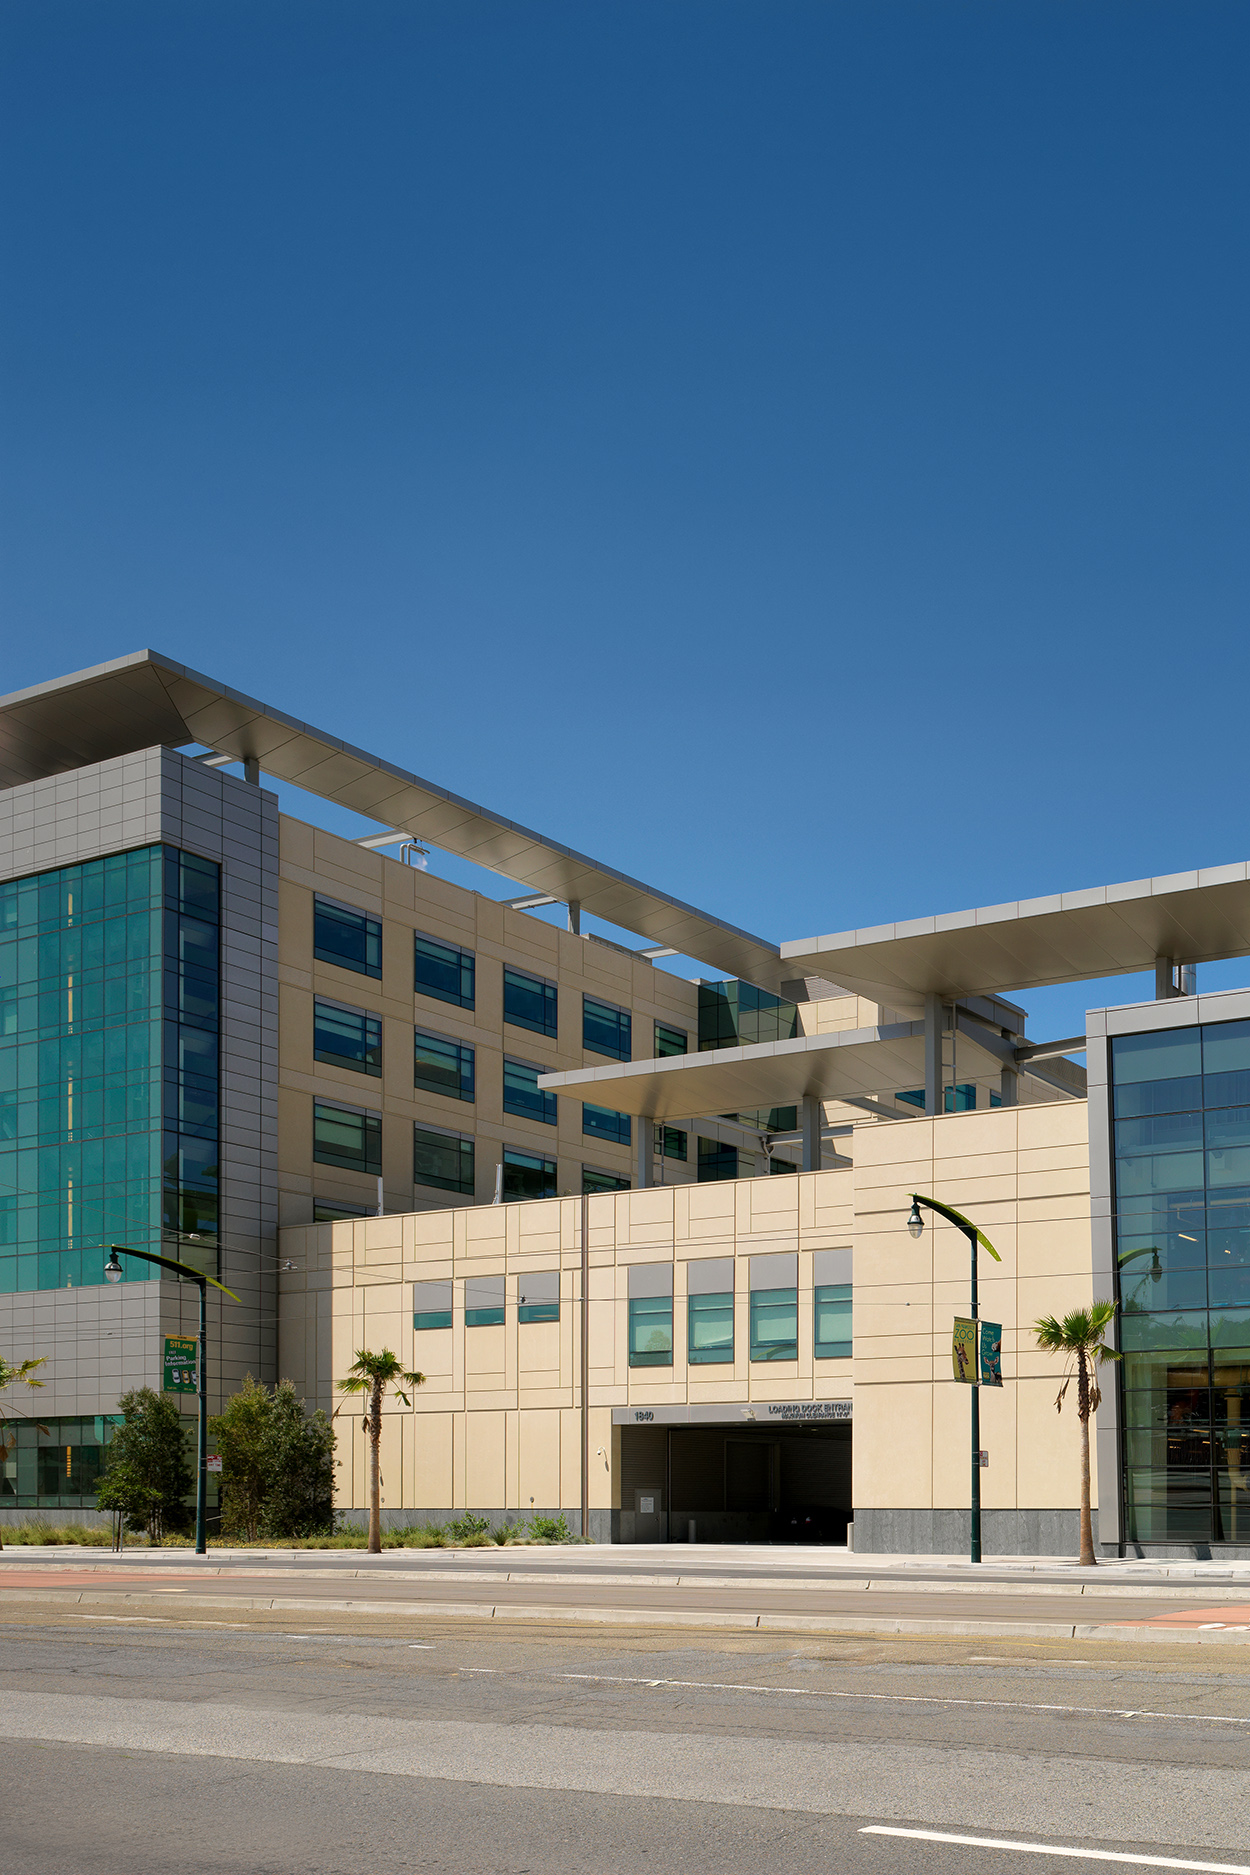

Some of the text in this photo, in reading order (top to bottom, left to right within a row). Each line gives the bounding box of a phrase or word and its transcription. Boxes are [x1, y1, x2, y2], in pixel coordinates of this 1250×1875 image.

[954, 1328, 974, 1340] ZOO
[170, 1341, 194, 1351] 511.org
[768, 1405, 800, 1414] LOADING
[802, 1404, 823, 1412] DOCK
[634, 1411, 654, 1421] 1840
